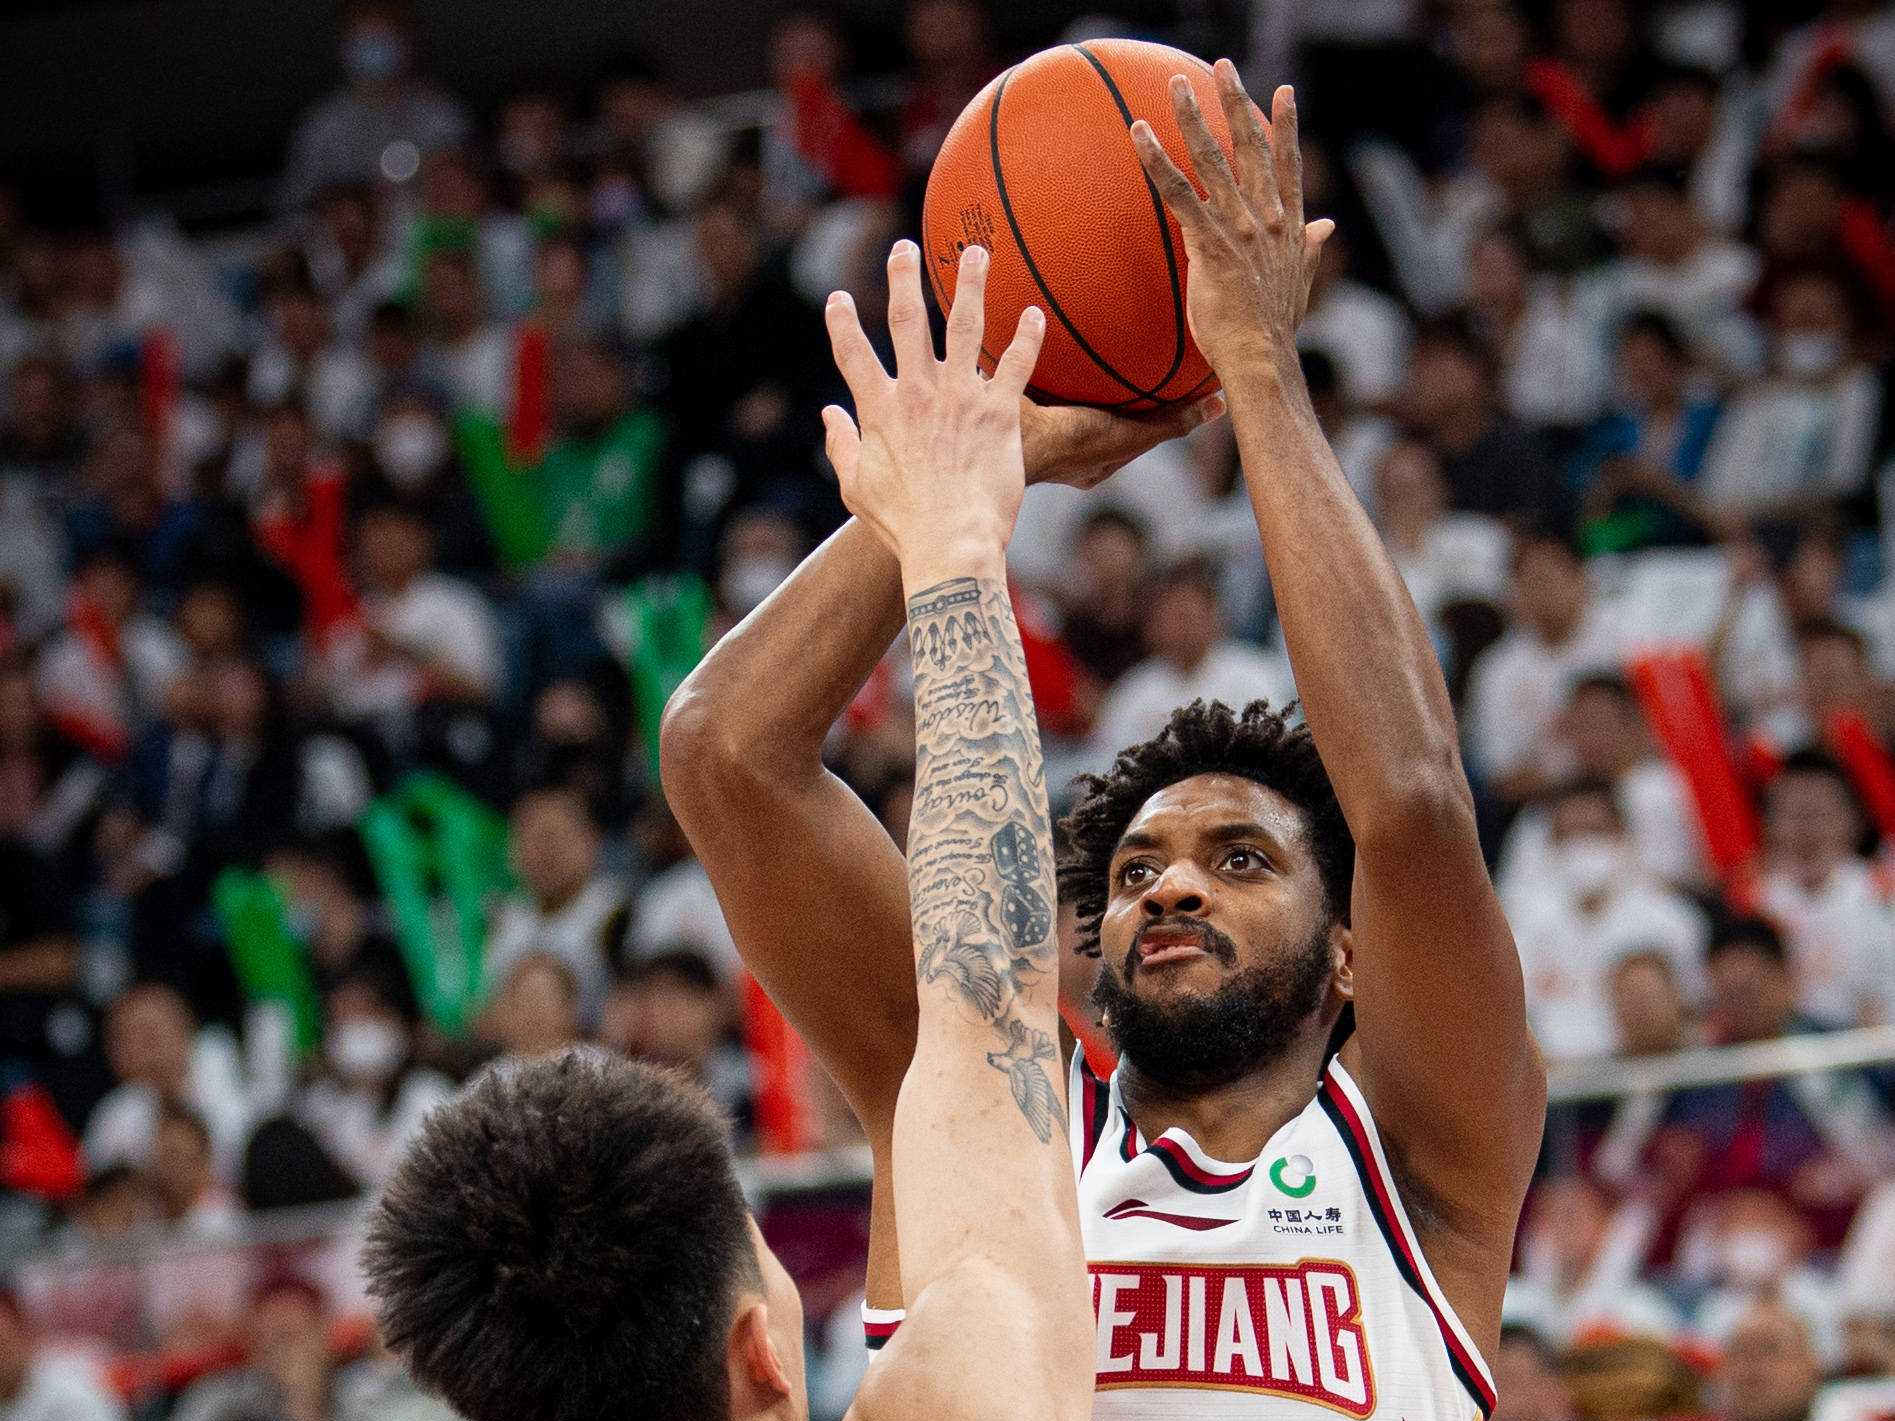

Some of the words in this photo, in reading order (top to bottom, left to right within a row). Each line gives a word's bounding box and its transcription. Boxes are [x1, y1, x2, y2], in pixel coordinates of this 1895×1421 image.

[1268, 1207, 1341, 1223] 中国人寿
[1273, 1225, 1312, 1234] CHINA
[1316, 1225, 1344, 1234] LIFE
[1088, 1271, 1367, 1405] EJIANG
